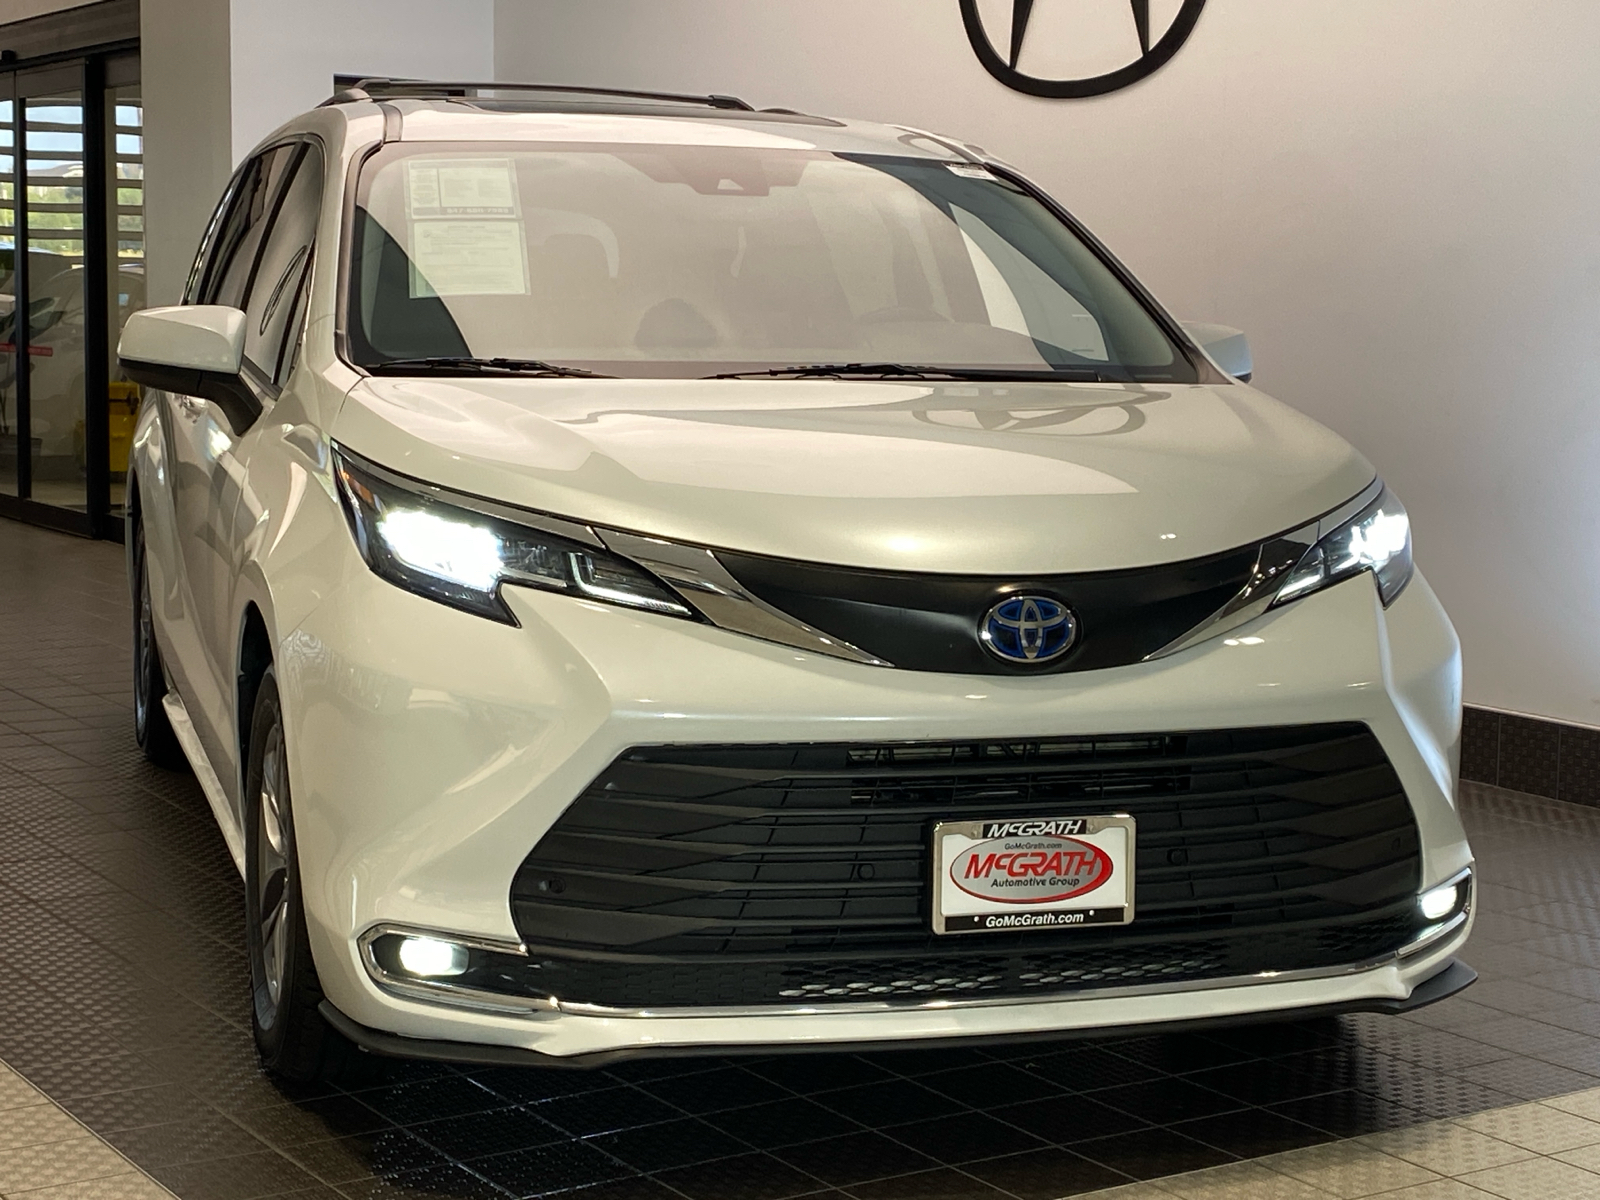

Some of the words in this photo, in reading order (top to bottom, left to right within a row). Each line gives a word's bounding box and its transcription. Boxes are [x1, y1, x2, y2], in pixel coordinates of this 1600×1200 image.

[1004, 842, 1063, 850] GoMcGrath.com
[991, 878, 1047, 888] Automotive
[1049, 876, 1080, 887] Group
[985, 912, 1084, 928] GoMcGrath.com
